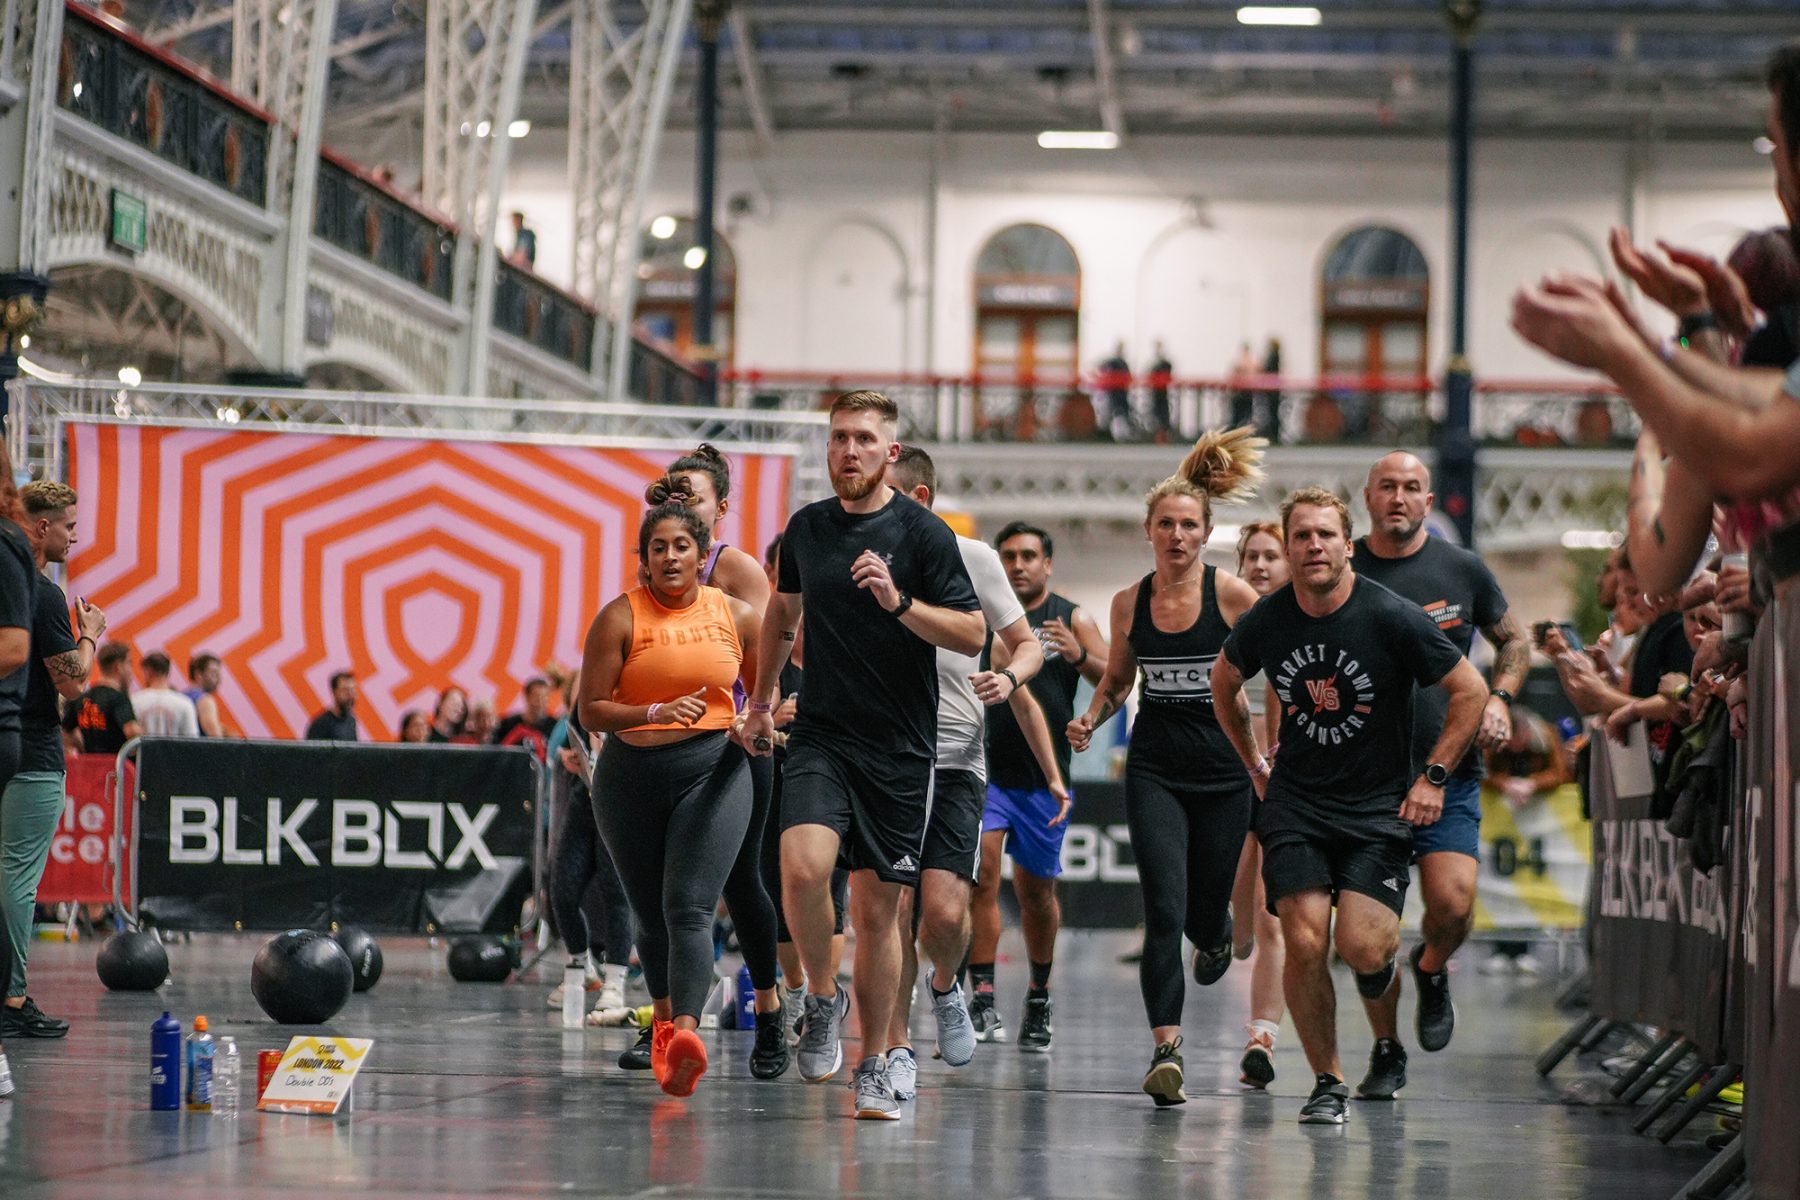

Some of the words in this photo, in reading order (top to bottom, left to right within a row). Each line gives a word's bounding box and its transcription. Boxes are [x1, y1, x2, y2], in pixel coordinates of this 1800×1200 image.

[1276, 644, 1325, 703] MARKET
[1335, 649, 1375, 702] TOWN
[1304, 679, 1340, 711] VS
[1296, 712, 1365, 746] CANCER
[57, 796, 105, 833] le
[50, 833, 127, 865] cer
[169, 795, 321, 866] BLK
[331, 798, 499, 870] BOX
[1058, 823, 1141, 883] BO
[285, 1075, 314, 1087] Double
[293, 1058, 323, 1070] LONDON
[322, 1059, 345, 1070] 2022
